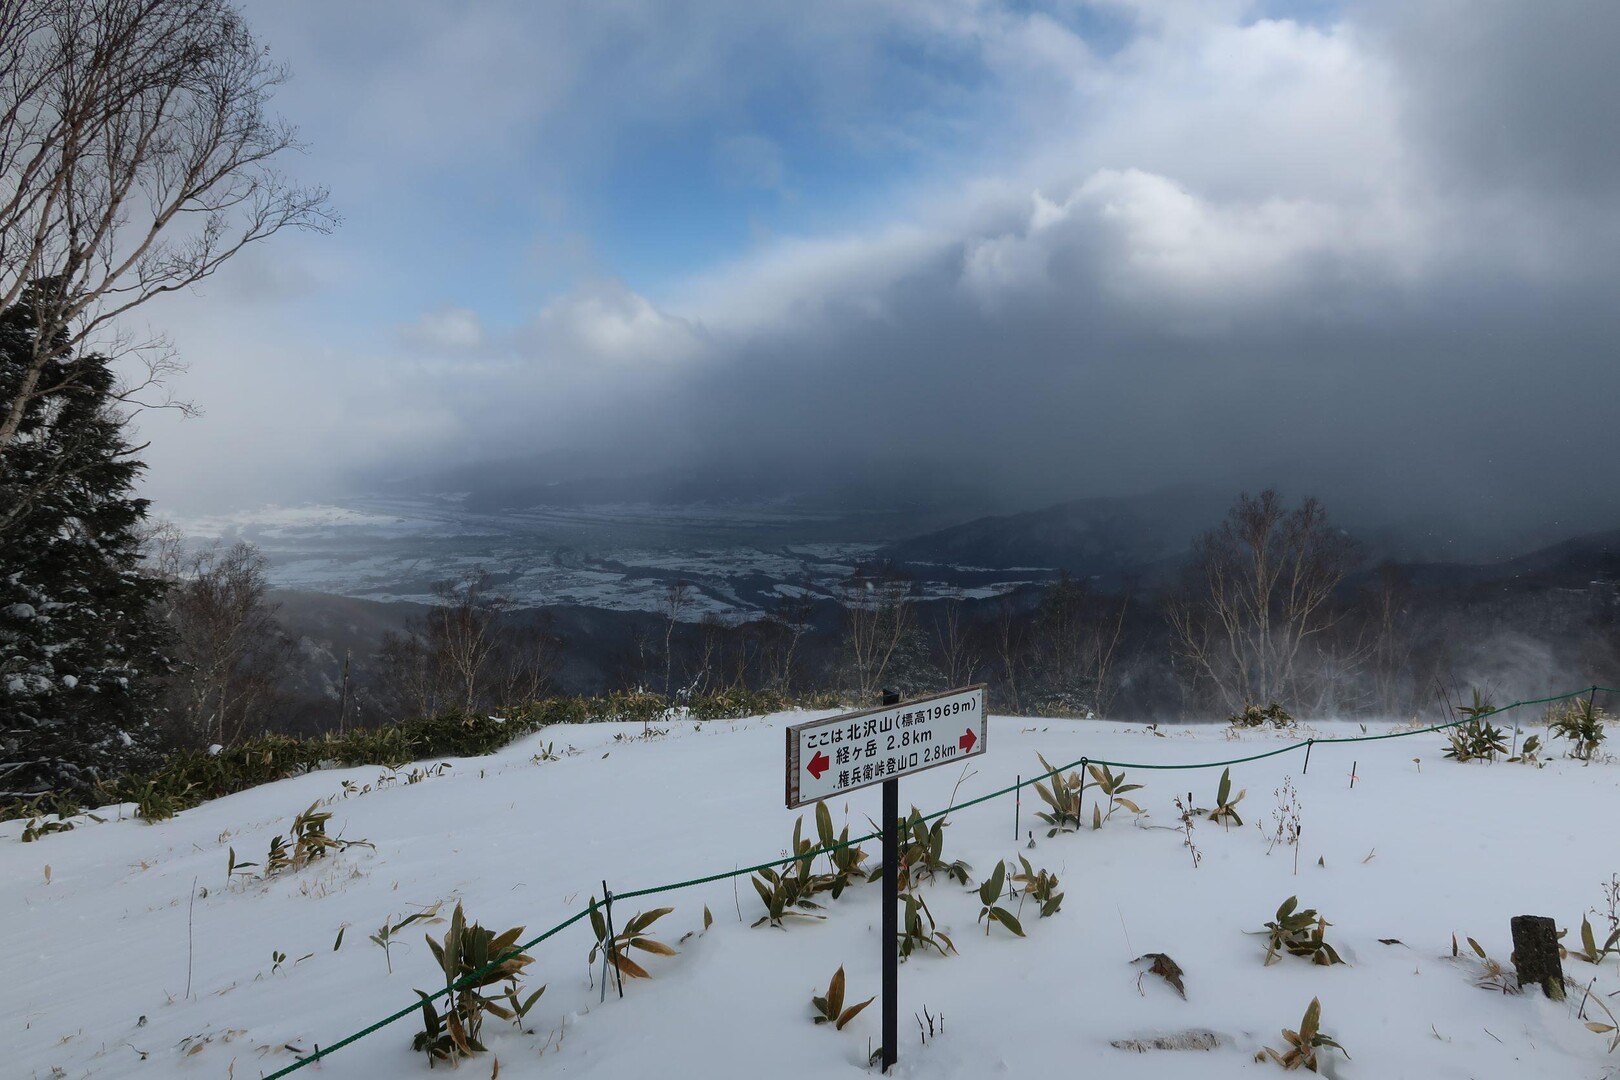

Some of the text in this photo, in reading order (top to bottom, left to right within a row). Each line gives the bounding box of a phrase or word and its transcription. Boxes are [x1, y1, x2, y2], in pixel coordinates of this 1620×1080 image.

[887, 729, 932, 751] 2.8km
[838, 744, 956, 789] 権兵衛峠登山口 2.8km
